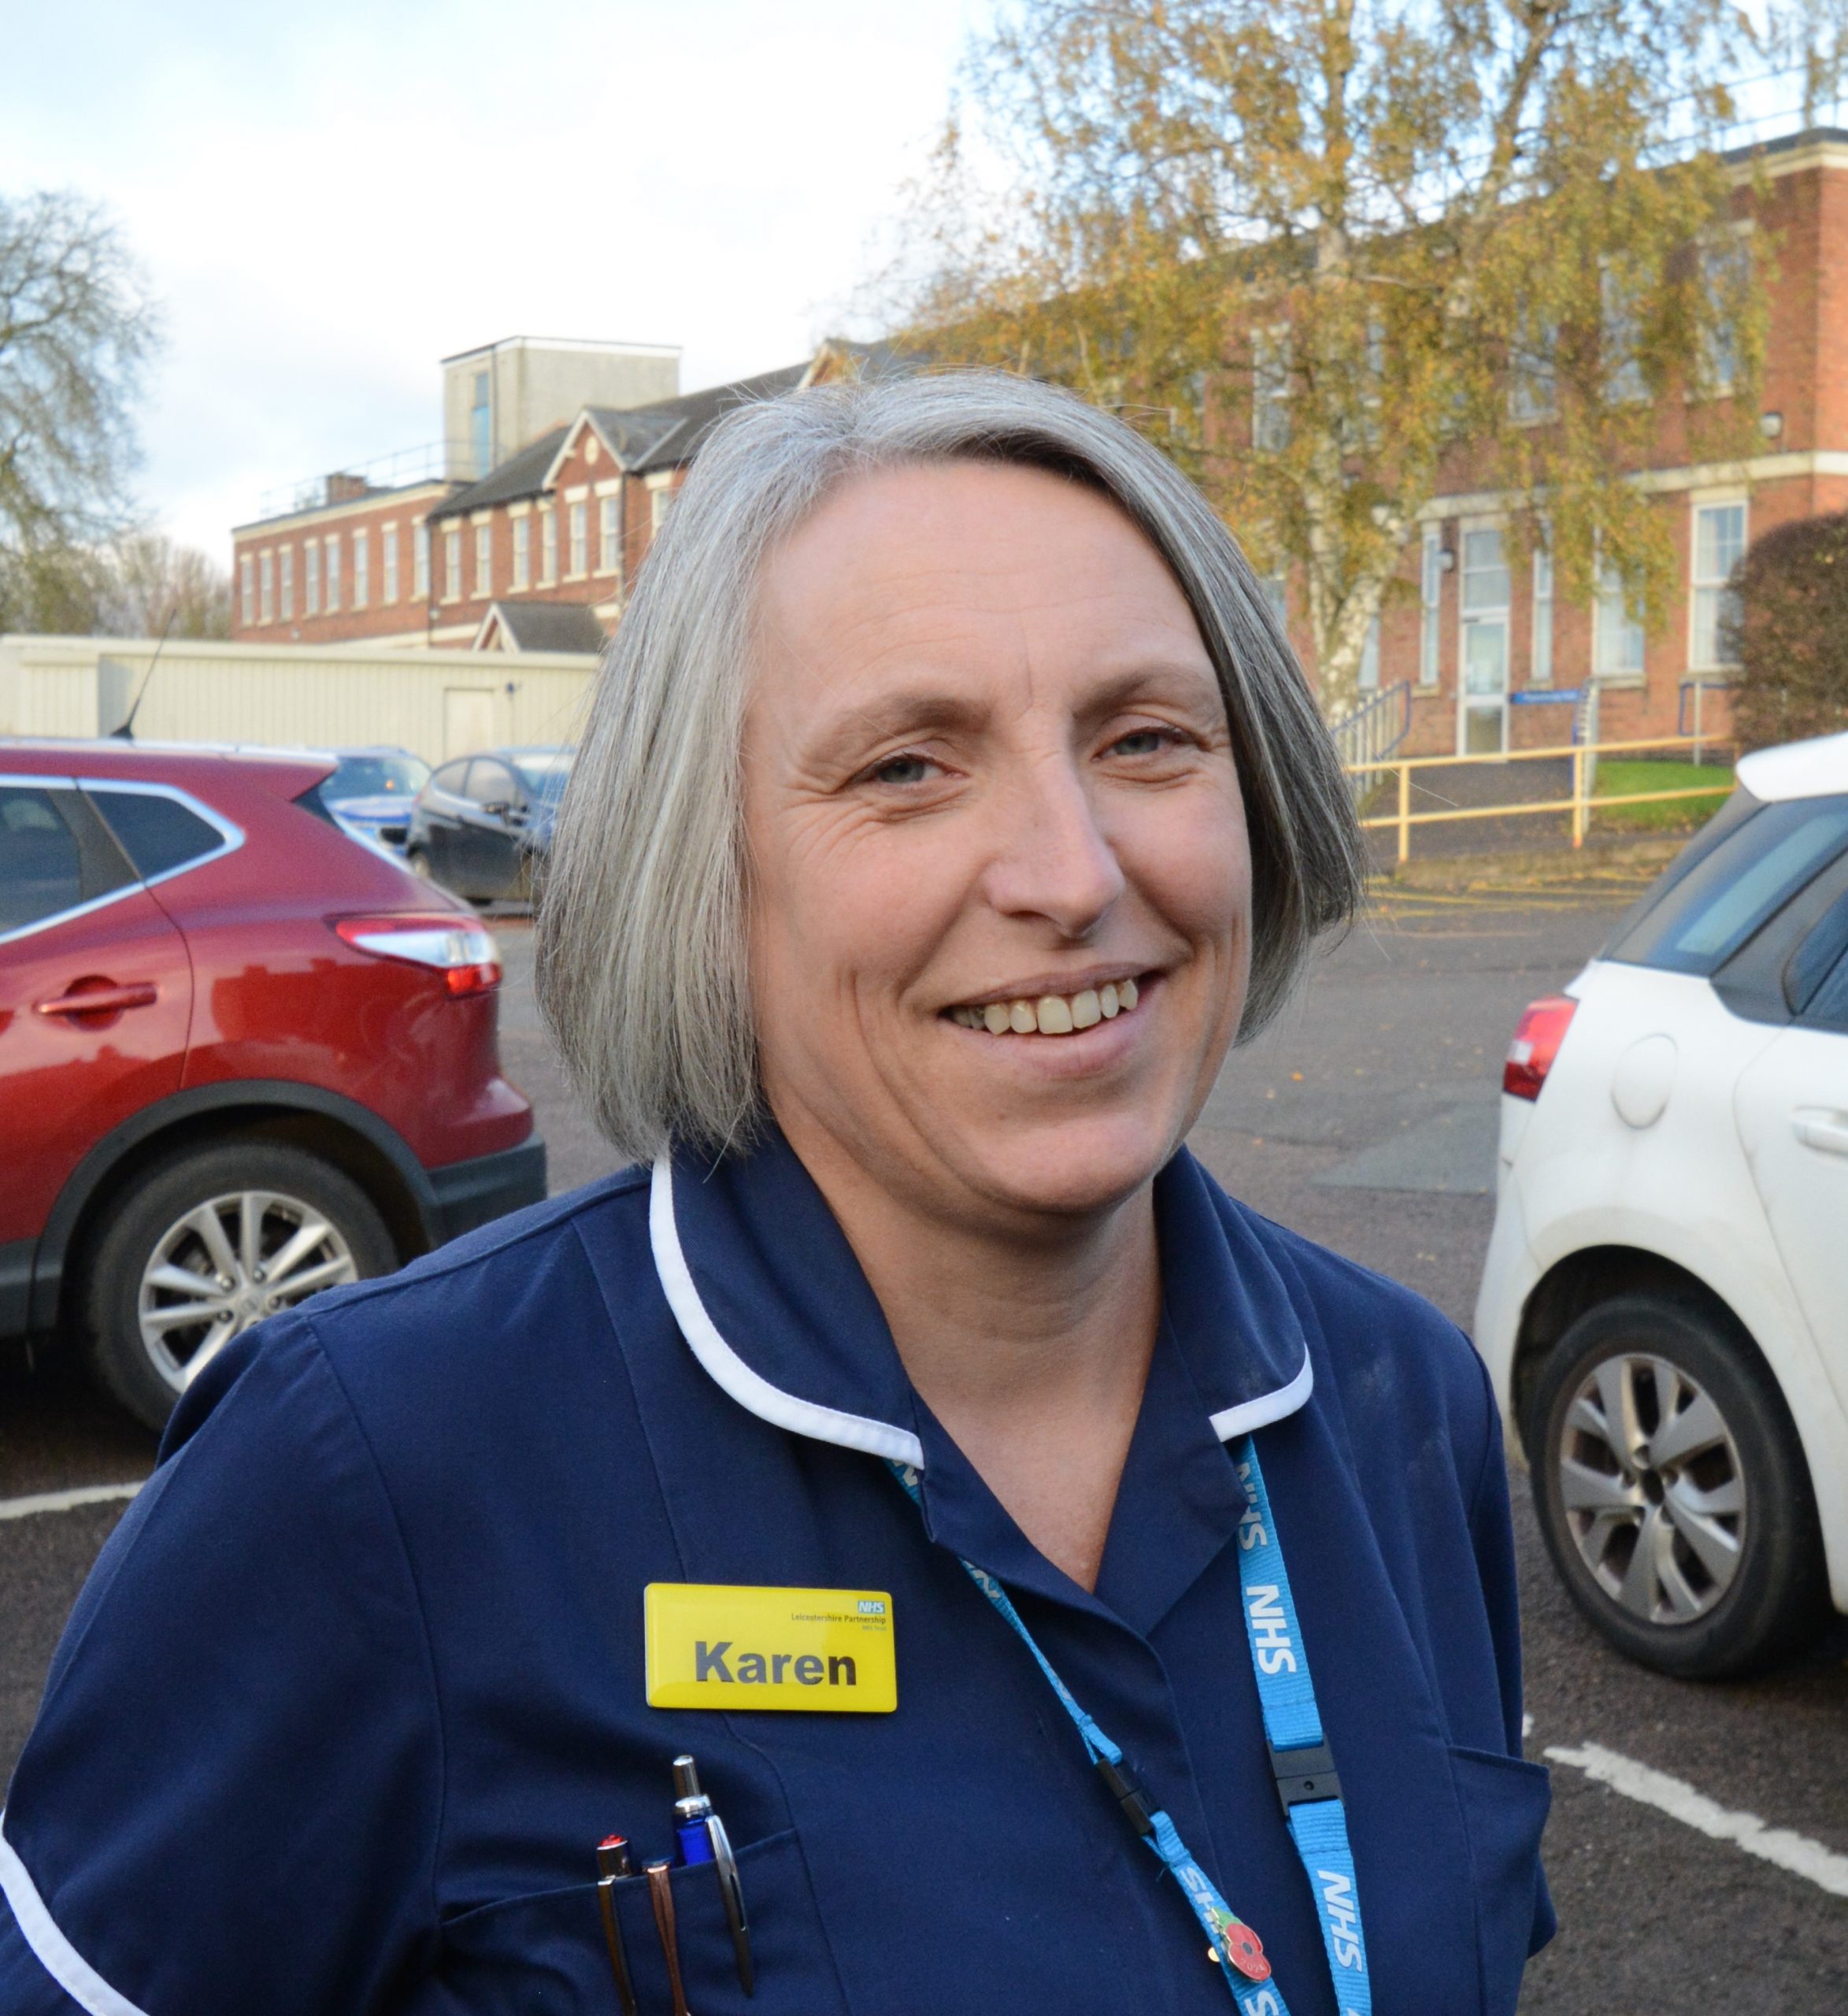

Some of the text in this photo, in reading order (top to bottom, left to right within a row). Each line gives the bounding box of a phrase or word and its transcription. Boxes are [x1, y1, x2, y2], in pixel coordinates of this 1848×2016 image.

[791, 1613, 842, 1622] Leicestershire
[844, 1615, 887, 1625] Partnership
[857, 1601, 884, 1614] NHS
[1246, 1585, 1297, 1674] NHS
[695, 1641, 857, 1686] Karen
[1317, 1870, 1362, 1973] NHS
